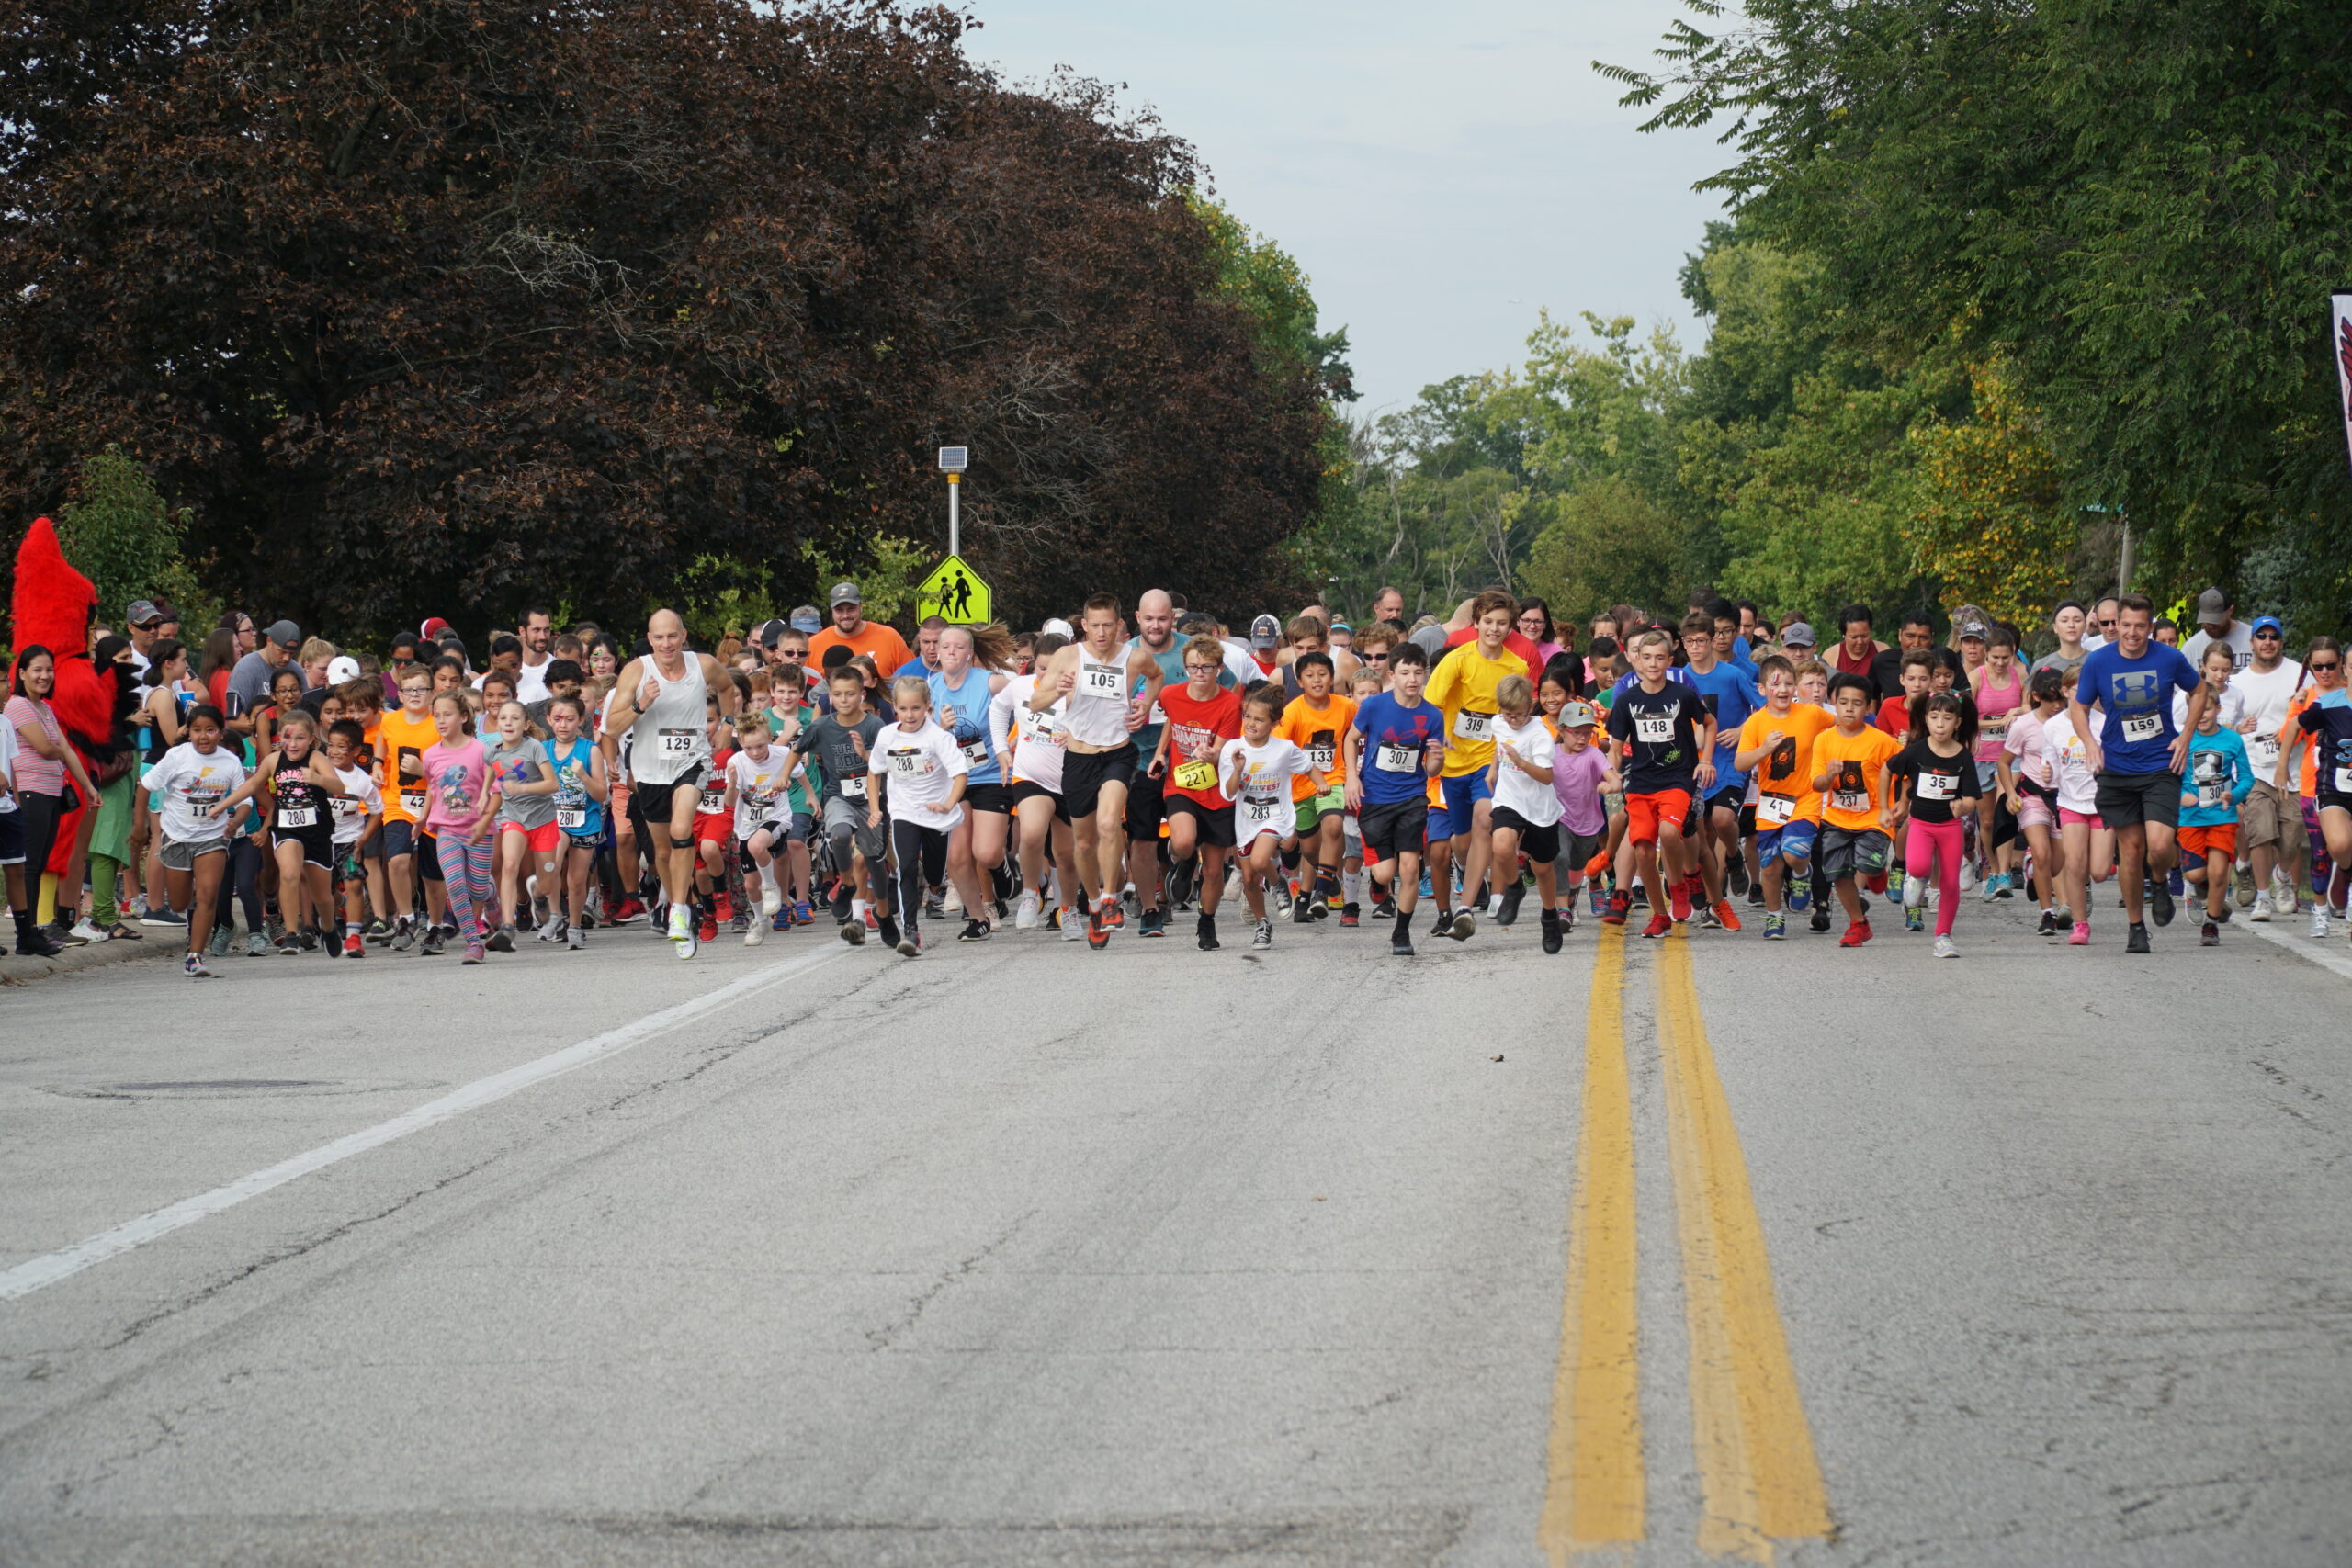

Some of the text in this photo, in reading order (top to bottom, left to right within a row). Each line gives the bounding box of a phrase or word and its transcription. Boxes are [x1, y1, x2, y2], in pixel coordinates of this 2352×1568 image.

[1090, 673, 1116, 688] 105
[1027, 712, 1044, 725] 37
[1464, 717, 1484, 732] 319
[2130, 718, 2155, 732] 159
[1642, 720, 1668, 733] 148
[665, 737, 691, 750] 129
[1310, 750, 1333, 763] 133
[1388, 750, 1409, 765] 307
[896, 757, 914, 772] 288
[1185, 769, 1207, 787] 221
[1929, 775, 1947, 789] 35
[331, 800, 347, 811] 47
[410, 796, 424, 807] 42
[702, 795, 718, 807] 64
[1770, 798, 1783, 812] 41
[1839, 795, 1858, 808] 237
[287, 809, 306, 826] 280
[559, 811, 575, 826] 281
[1250, 806, 1271, 820] 283
